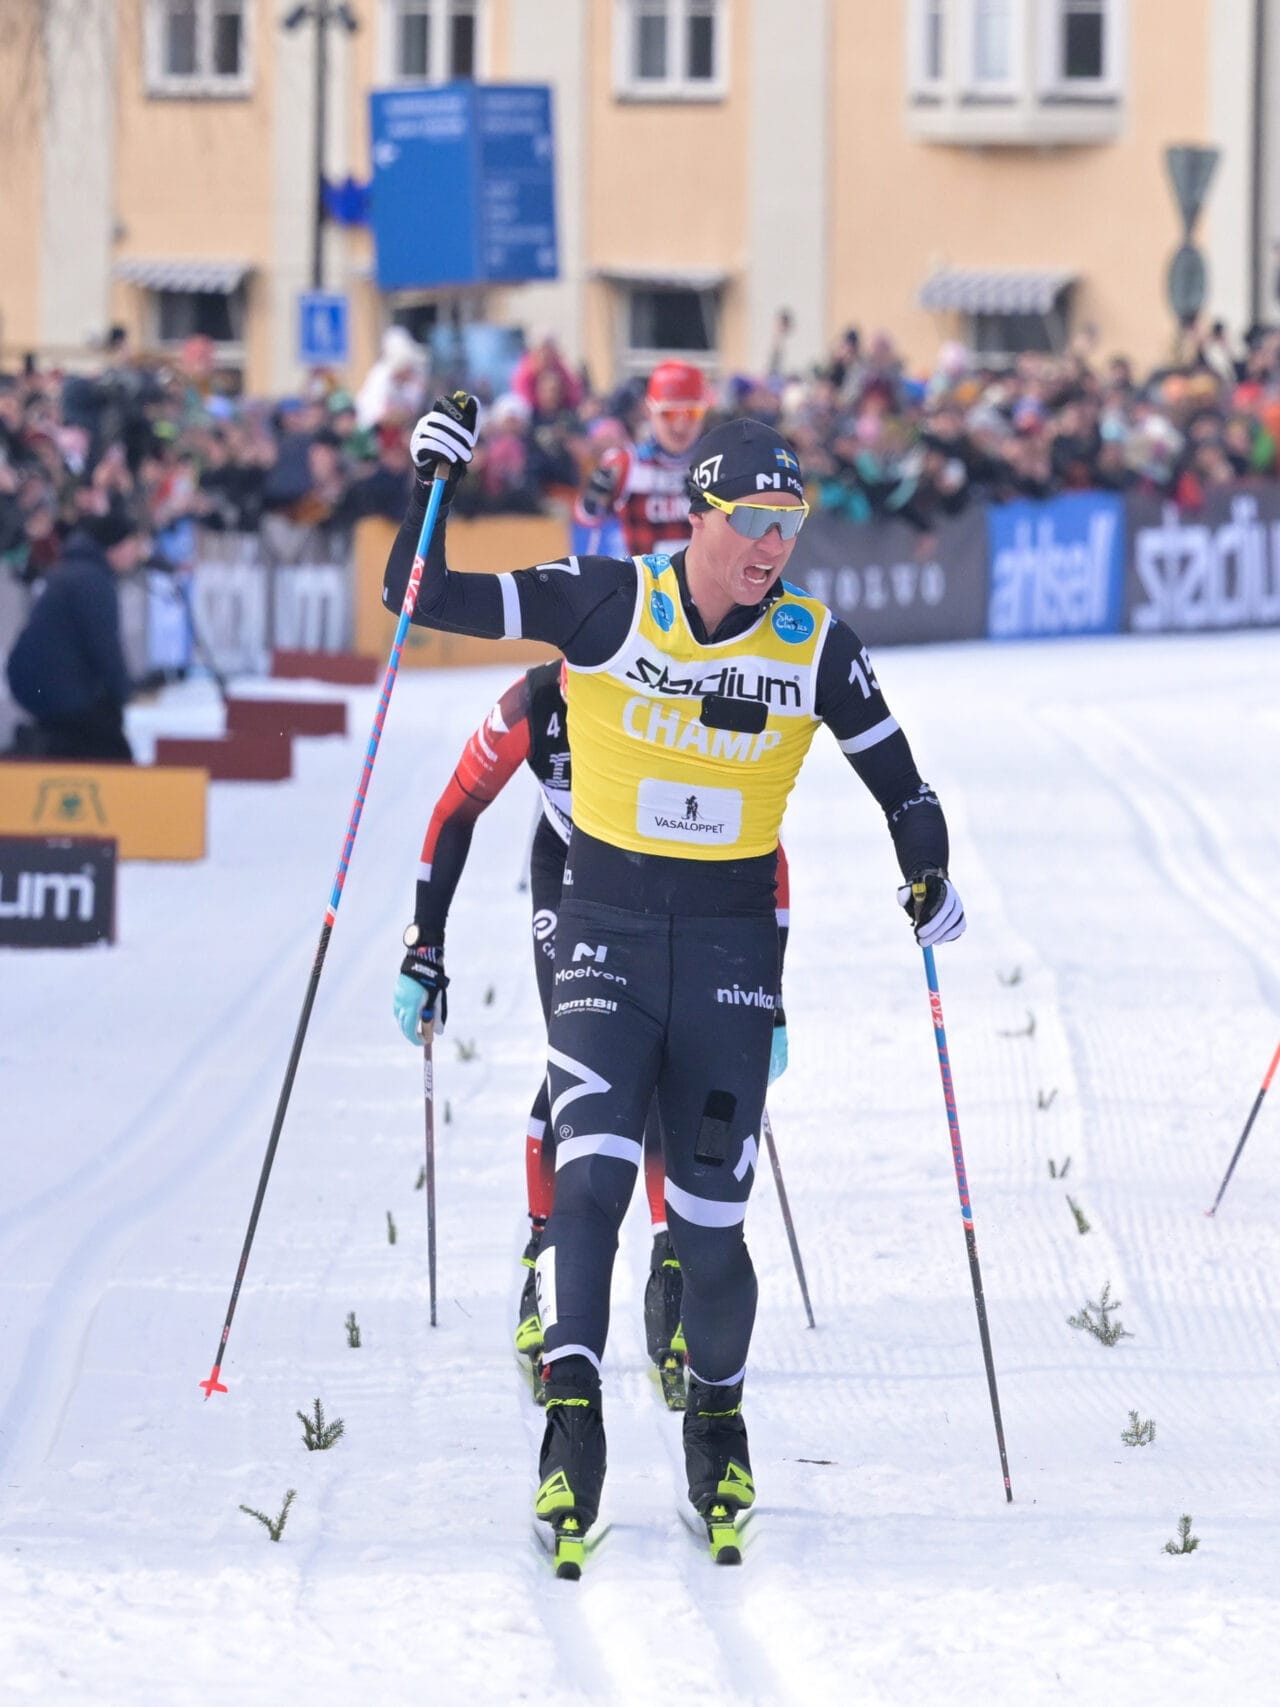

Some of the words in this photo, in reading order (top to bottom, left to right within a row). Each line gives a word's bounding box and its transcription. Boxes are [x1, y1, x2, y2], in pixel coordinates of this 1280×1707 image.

[692, 453, 724, 490] 157
[546, 712, 560, 738] 4
[622, 695, 782, 763] CHAMP
[655, 816, 725, 834] VASALOPPET
